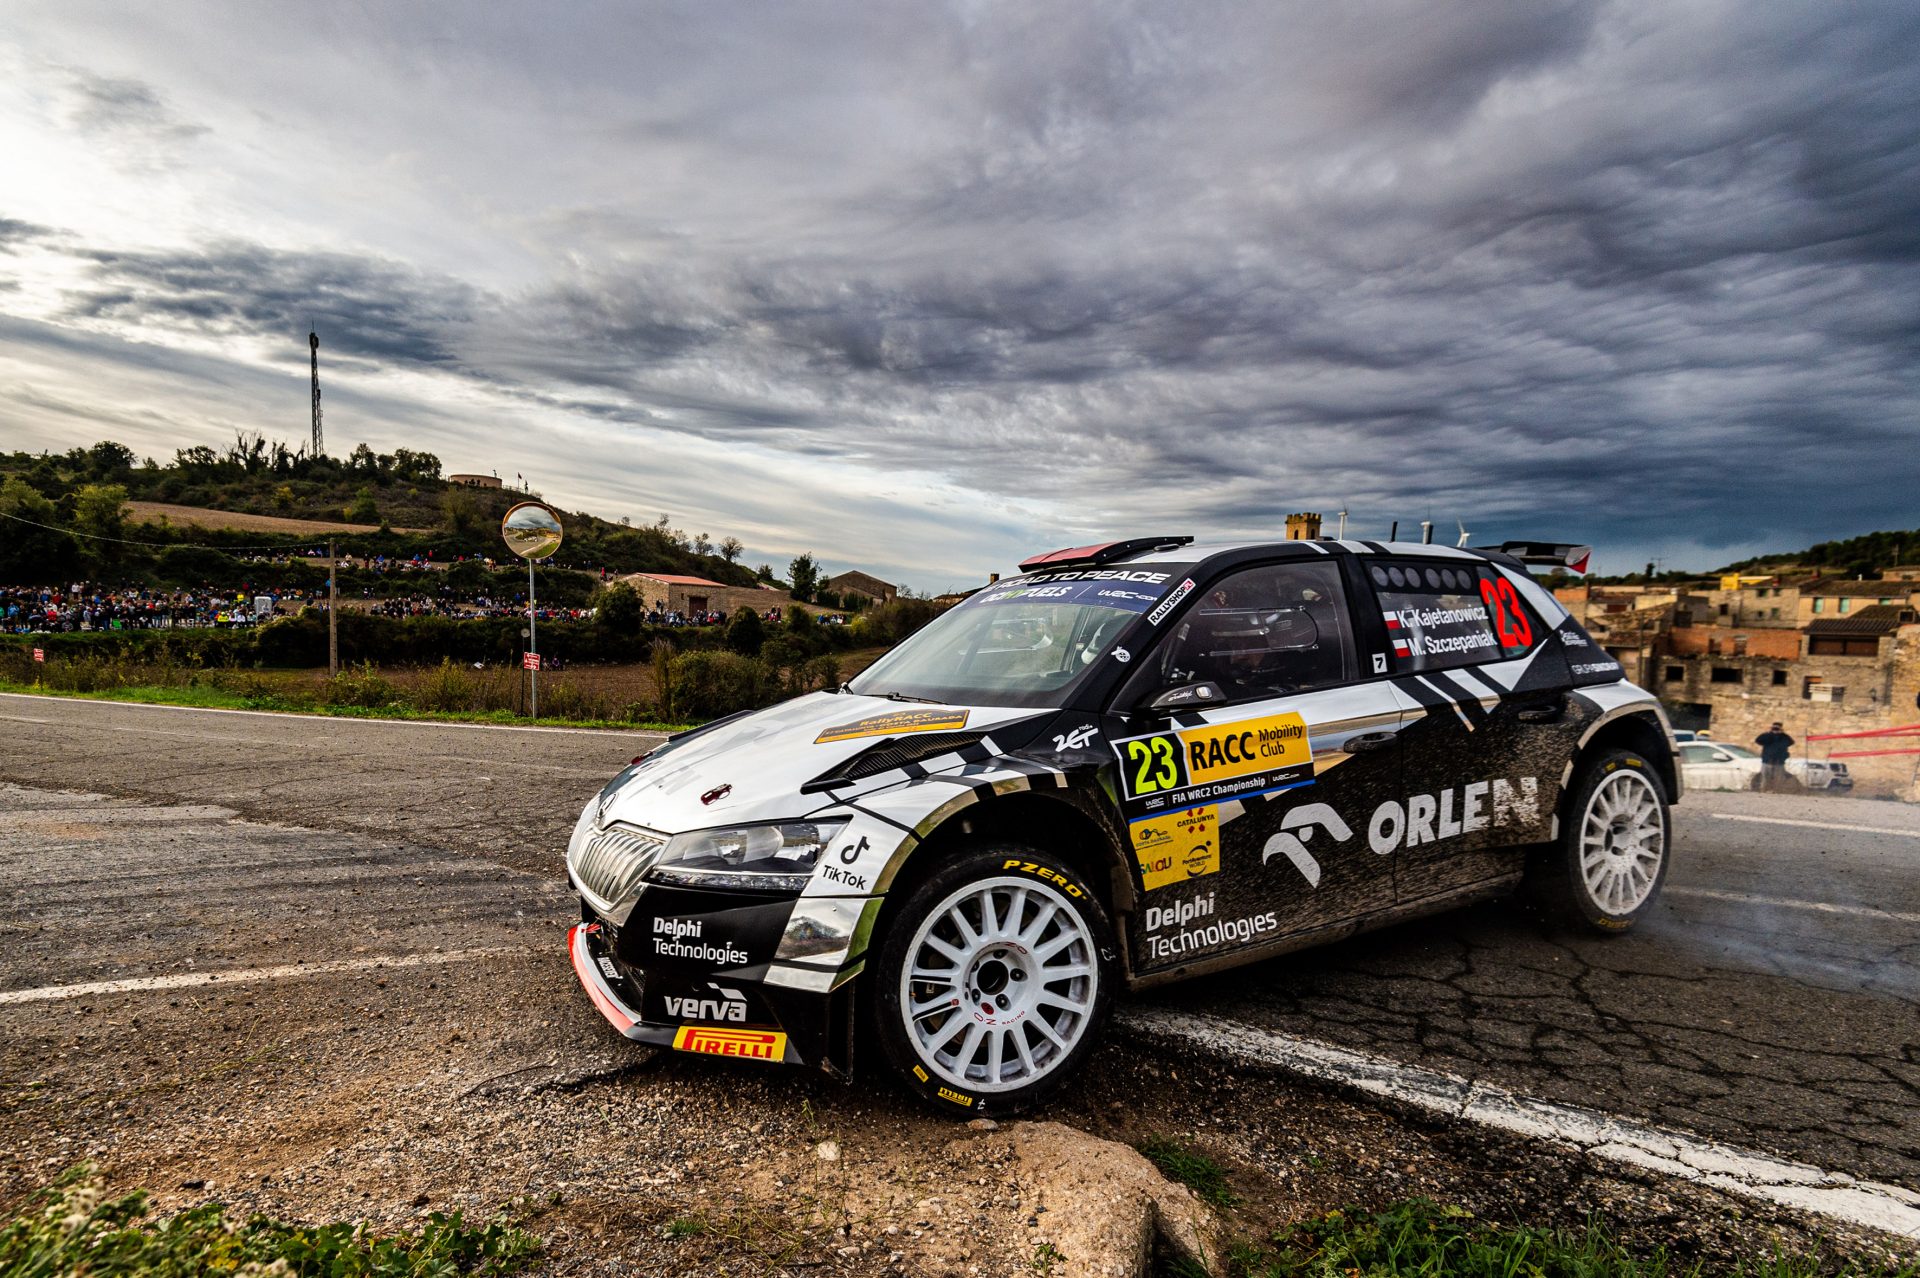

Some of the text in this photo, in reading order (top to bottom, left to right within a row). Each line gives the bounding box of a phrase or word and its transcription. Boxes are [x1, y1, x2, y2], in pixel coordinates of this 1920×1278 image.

[1052, 572, 1082, 582] TO
[1079, 570, 1172, 584] PEACE
[1412, 604, 1489, 629] Kajetanowicz
[1479, 577, 1533, 647] 23
[1406, 629, 1498, 657] M. Szczepaniak
[1374, 657, 1384, 669] 7
[1258, 724, 1303, 742] Mobility
[1189, 731, 1256, 772] RACC
[1260, 741, 1285, 757] Club
[1127, 736, 1178, 795] 23
[1172, 792, 1187, 804] FIA
[1187, 787, 1211, 801] WRC2
[1212, 777, 1266, 795] Championship
[1177, 814, 1215, 828] CATALUNYA
[1367, 776, 1541, 855] ORLEN
[822, 864, 867, 890] TikTok
[1140, 856, 1172, 874] SALOU
[1146, 891, 1215, 932] Delphi
[653, 917, 702, 939] Delphi
[1146, 912, 1278, 959] Technologies
[652, 937, 748, 965] Technologies
[663, 995, 748, 1022] verva
[681, 1029, 776, 1060] PIRELLI
